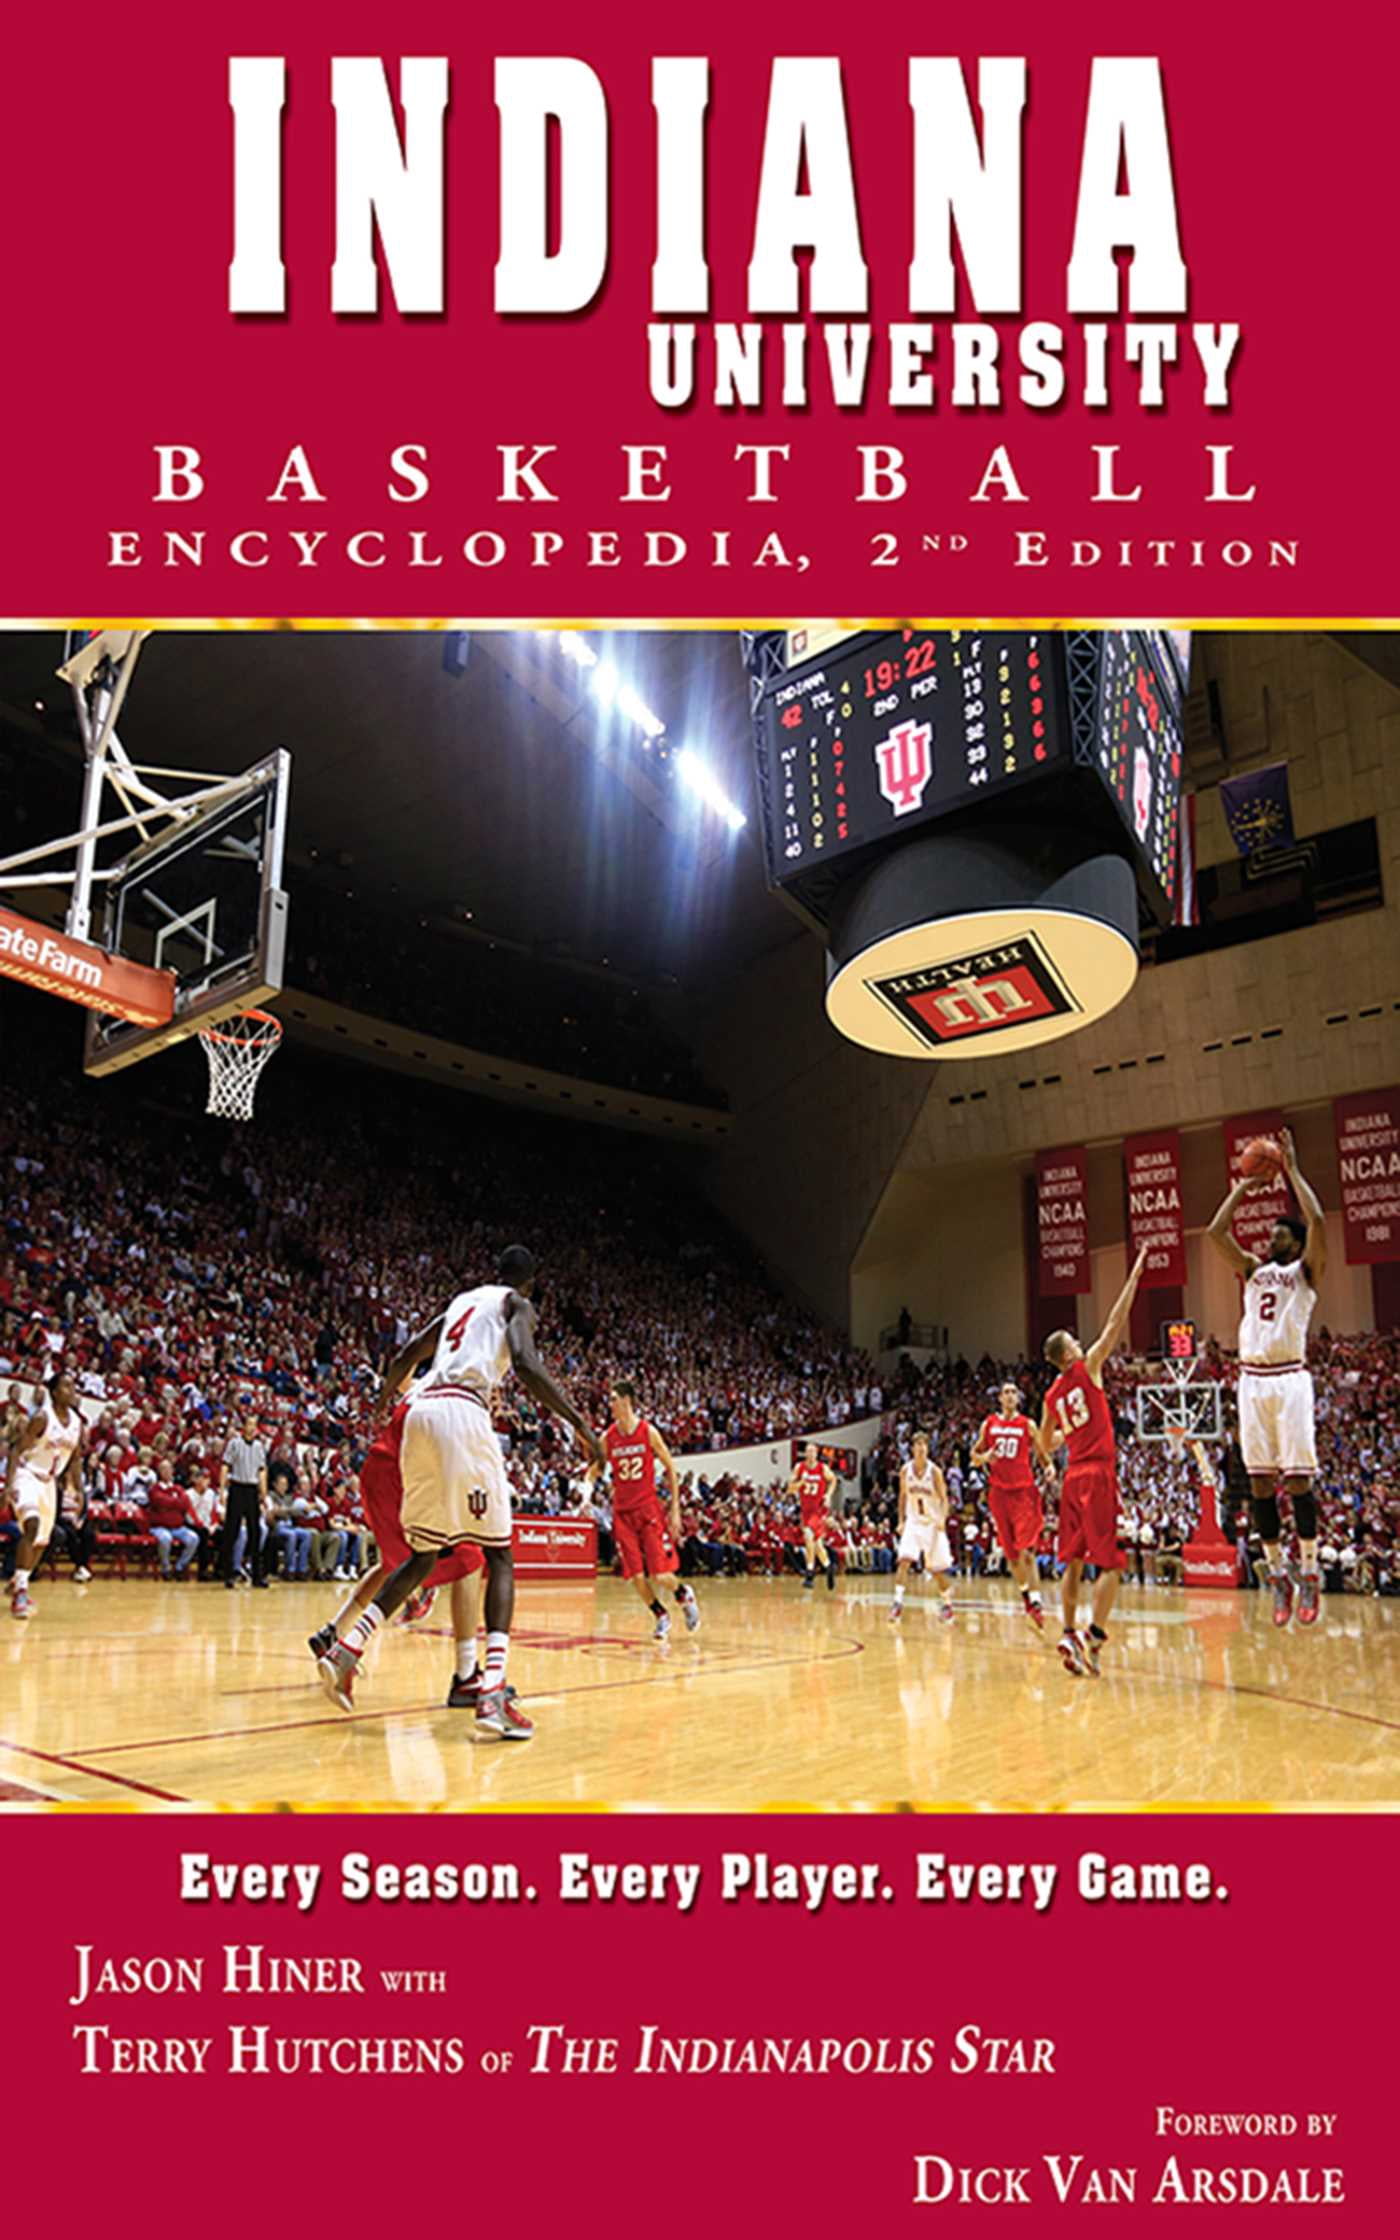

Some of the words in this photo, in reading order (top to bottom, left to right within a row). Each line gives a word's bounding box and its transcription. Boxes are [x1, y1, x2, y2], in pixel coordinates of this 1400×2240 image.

[864, 639, 937, 698] 19:22
[781, 703, 803, 729] 42
[890, 946, 1023, 994] HEALTH
[1341, 1152, 1400, 1182] NCAA
[1039, 1201, 1086, 1226] NCAA
[1129, 1188, 1181, 1215] NCAA
[1260, 1293, 1277, 1321] 2
[446, 1305, 475, 1352] 4
[1055, 1386, 1091, 1437] 13
[995, 1437, 1018, 1459] 30
[618, 1456, 643, 1481] 32
